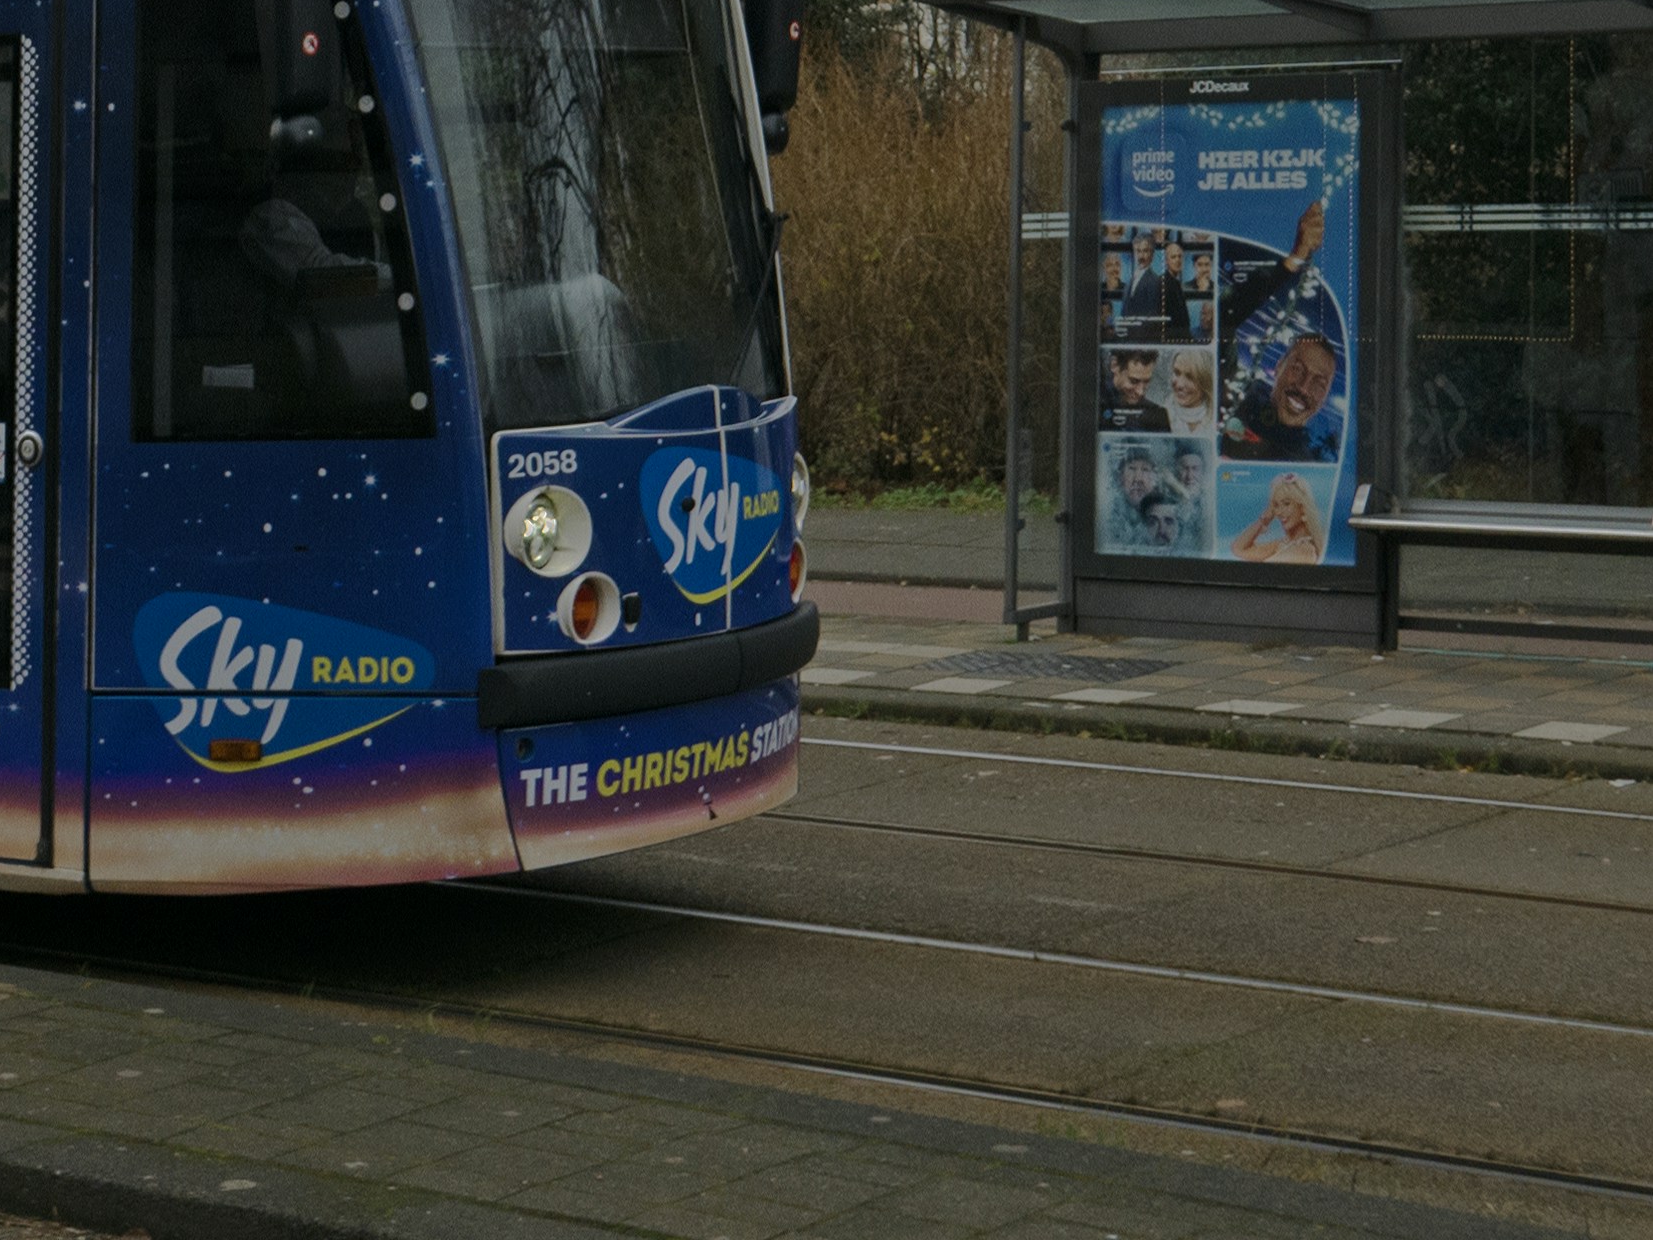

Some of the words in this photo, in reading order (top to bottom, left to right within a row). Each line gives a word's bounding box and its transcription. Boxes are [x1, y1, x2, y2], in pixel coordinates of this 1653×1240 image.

[1189, 80, 1250, 94] JCDecaux
[1132, 148, 1175, 166] prime
[1198, 150, 1259, 169] HIER
[1261, 148, 1326, 168] KIJK
[1132, 167, 1175, 182] video
[1198, 172, 1228, 191] JE
[1230, 171, 1308, 190] ALLES
[508, 448, 578, 479] 2058
[658, 457, 739, 576] Sky
[743, 490, 780, 520] RADIO
[159, 605, 303, 745] Sky
[312, 656, 416, 684] RADIO
[520, 762, 588, 807] THE
[596, 730, 750, 797] CHRISTMAS
